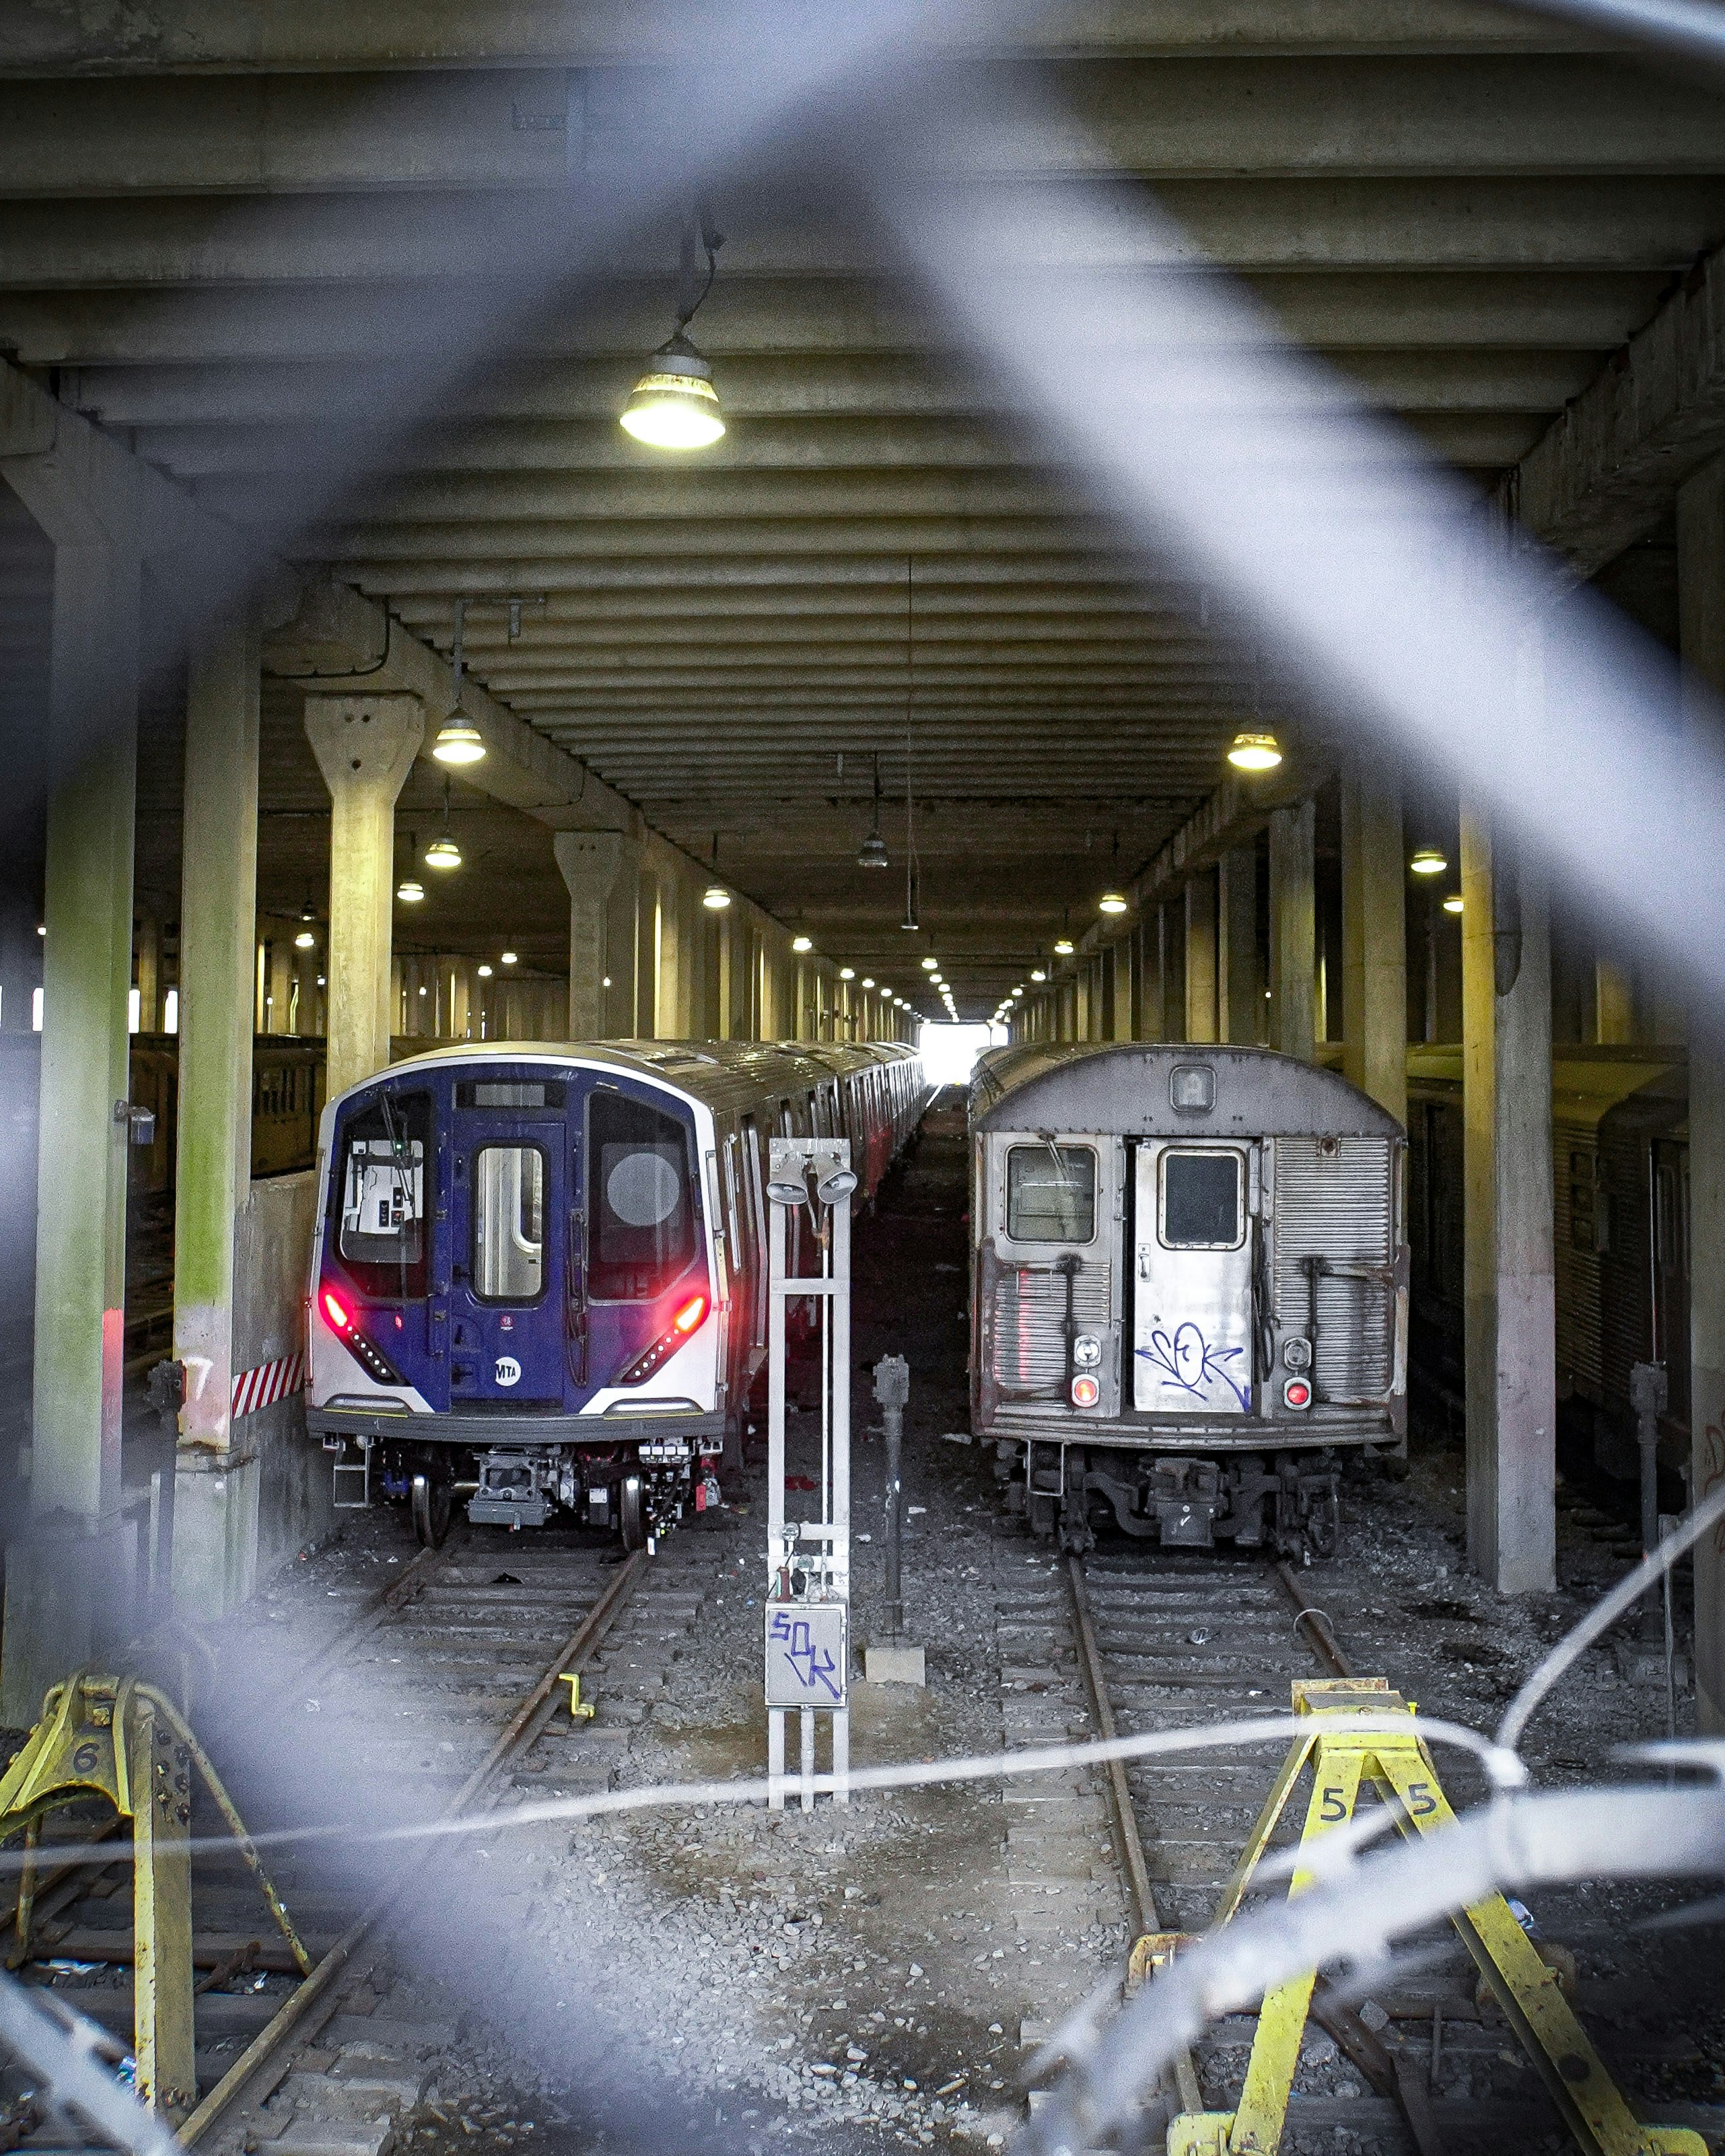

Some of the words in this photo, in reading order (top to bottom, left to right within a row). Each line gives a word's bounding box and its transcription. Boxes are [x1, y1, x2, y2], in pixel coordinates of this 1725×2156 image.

[495, 1364, 516, 1379] MTA
[73, 1742, 100, 1774] 6
[1321, 1787, 1347, 1821] 5
[1408, 1783, 1437, 1815] 5
